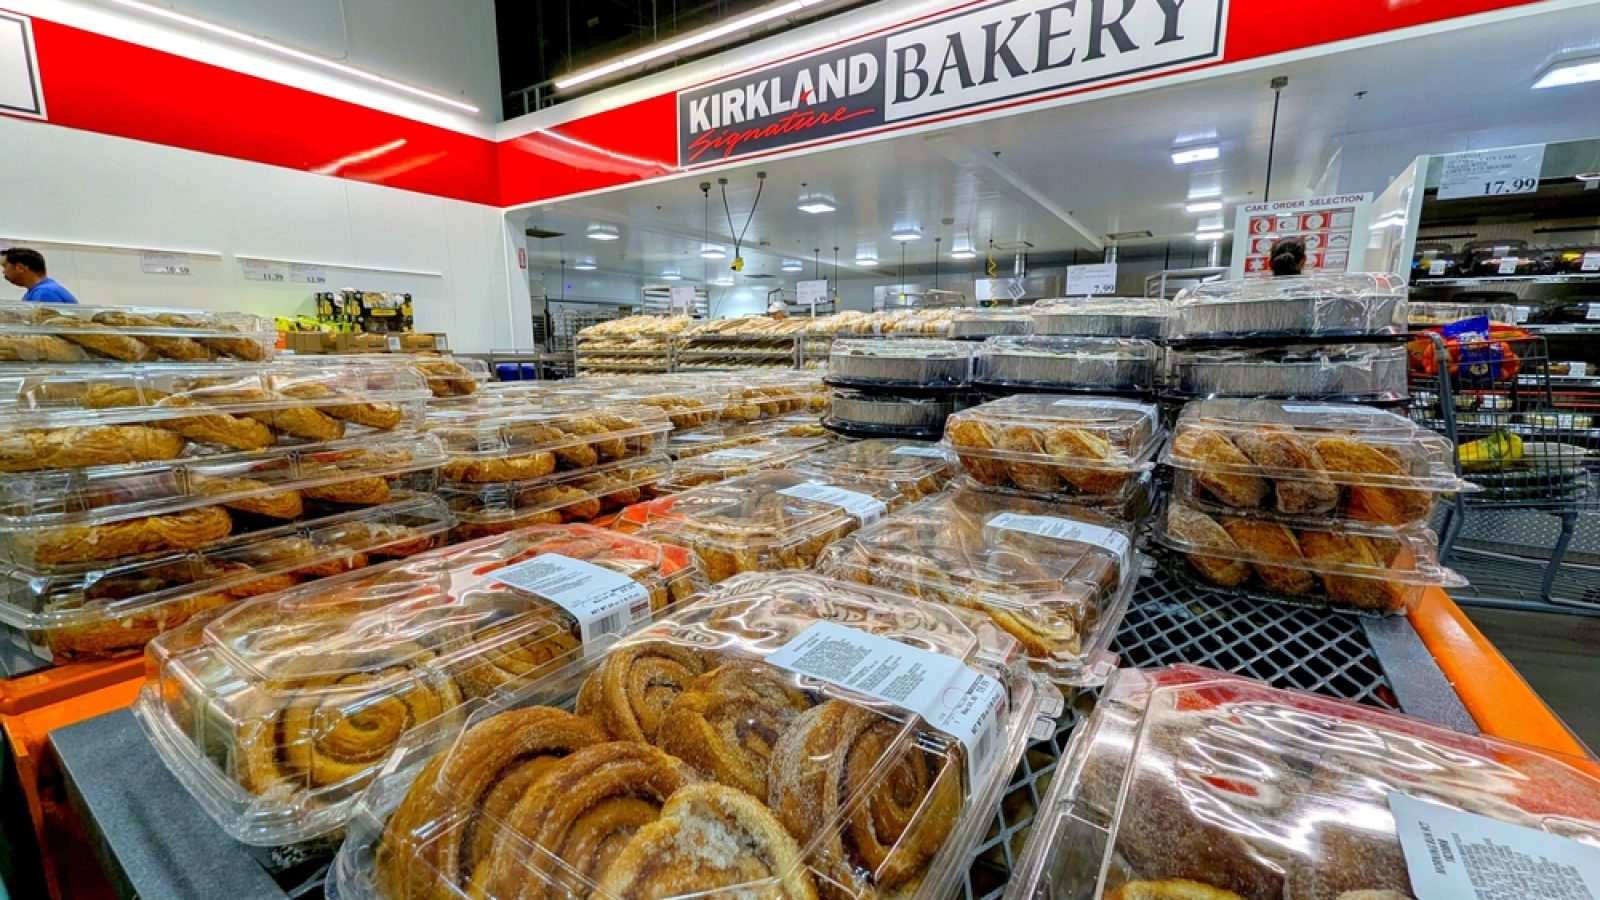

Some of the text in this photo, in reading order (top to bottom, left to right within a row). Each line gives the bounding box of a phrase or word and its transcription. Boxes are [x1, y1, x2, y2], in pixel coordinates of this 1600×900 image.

[689, 0, 1184, 134] KIRKLAND BAKERY
[688, 105, 876, 162] Signature
[1245, 194, 1364, 212] CAKE ORDER SELECTION
[1484, 178, 1536, 194] 17.99
